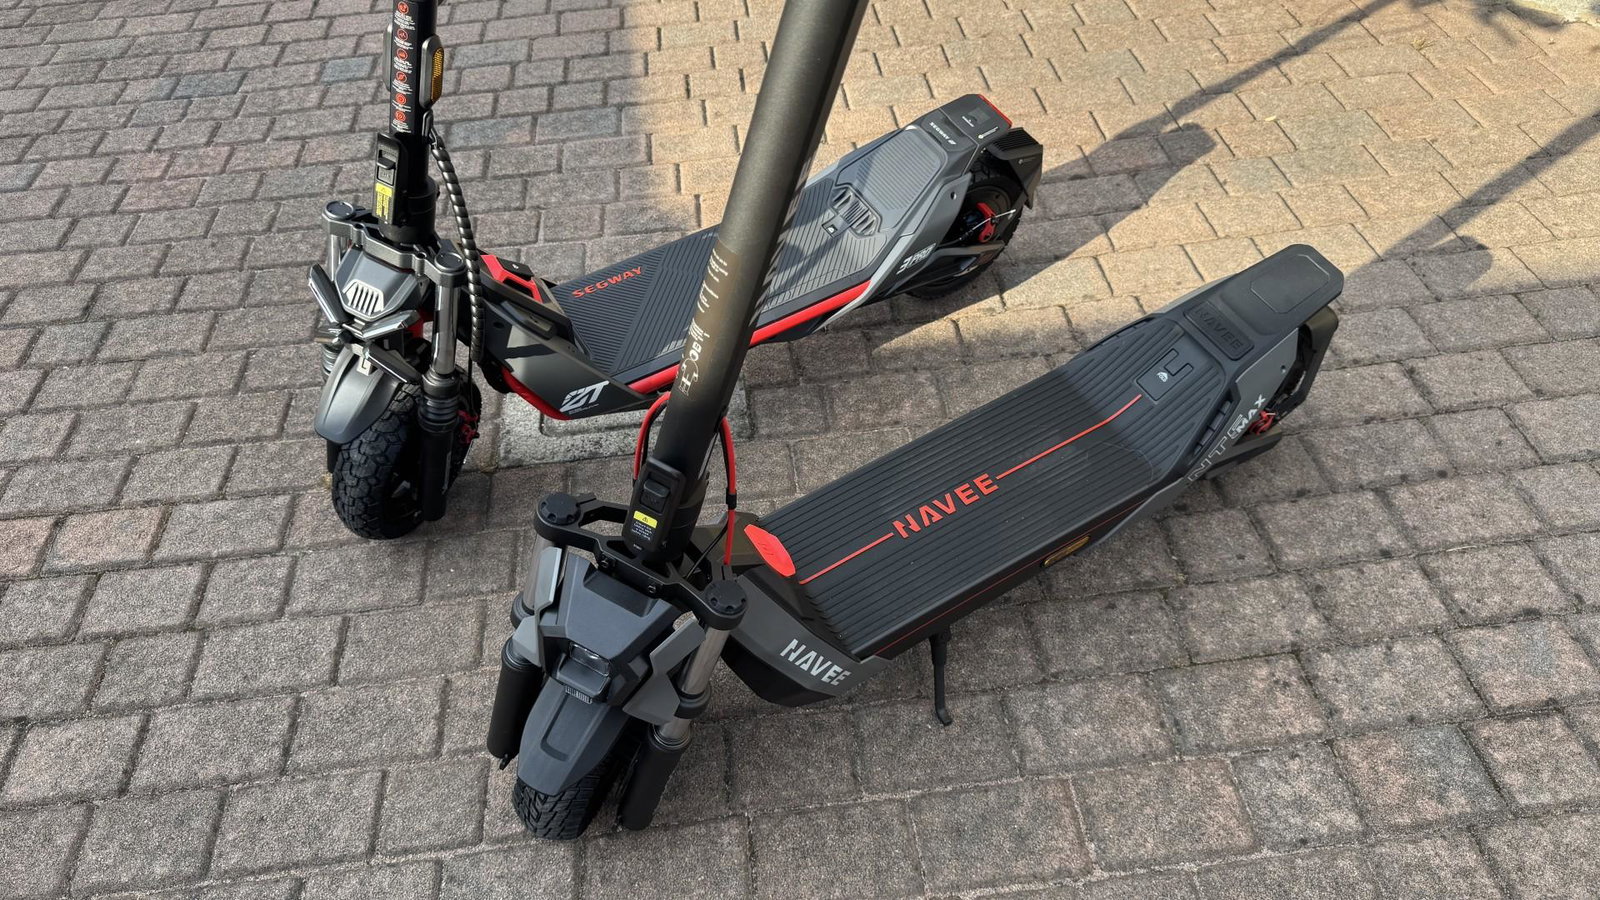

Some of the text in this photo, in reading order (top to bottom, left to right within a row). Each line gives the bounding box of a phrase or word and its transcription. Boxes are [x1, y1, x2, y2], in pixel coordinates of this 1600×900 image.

[571, 266, 644, 298] SEGWAY
[1193, 304, 1244, 351] NAVEE
[1236, 394, 1266, 434] MAX
[892, 473, 999, 539] NAVEE
[779, 638, 852, 686] NAVEE
